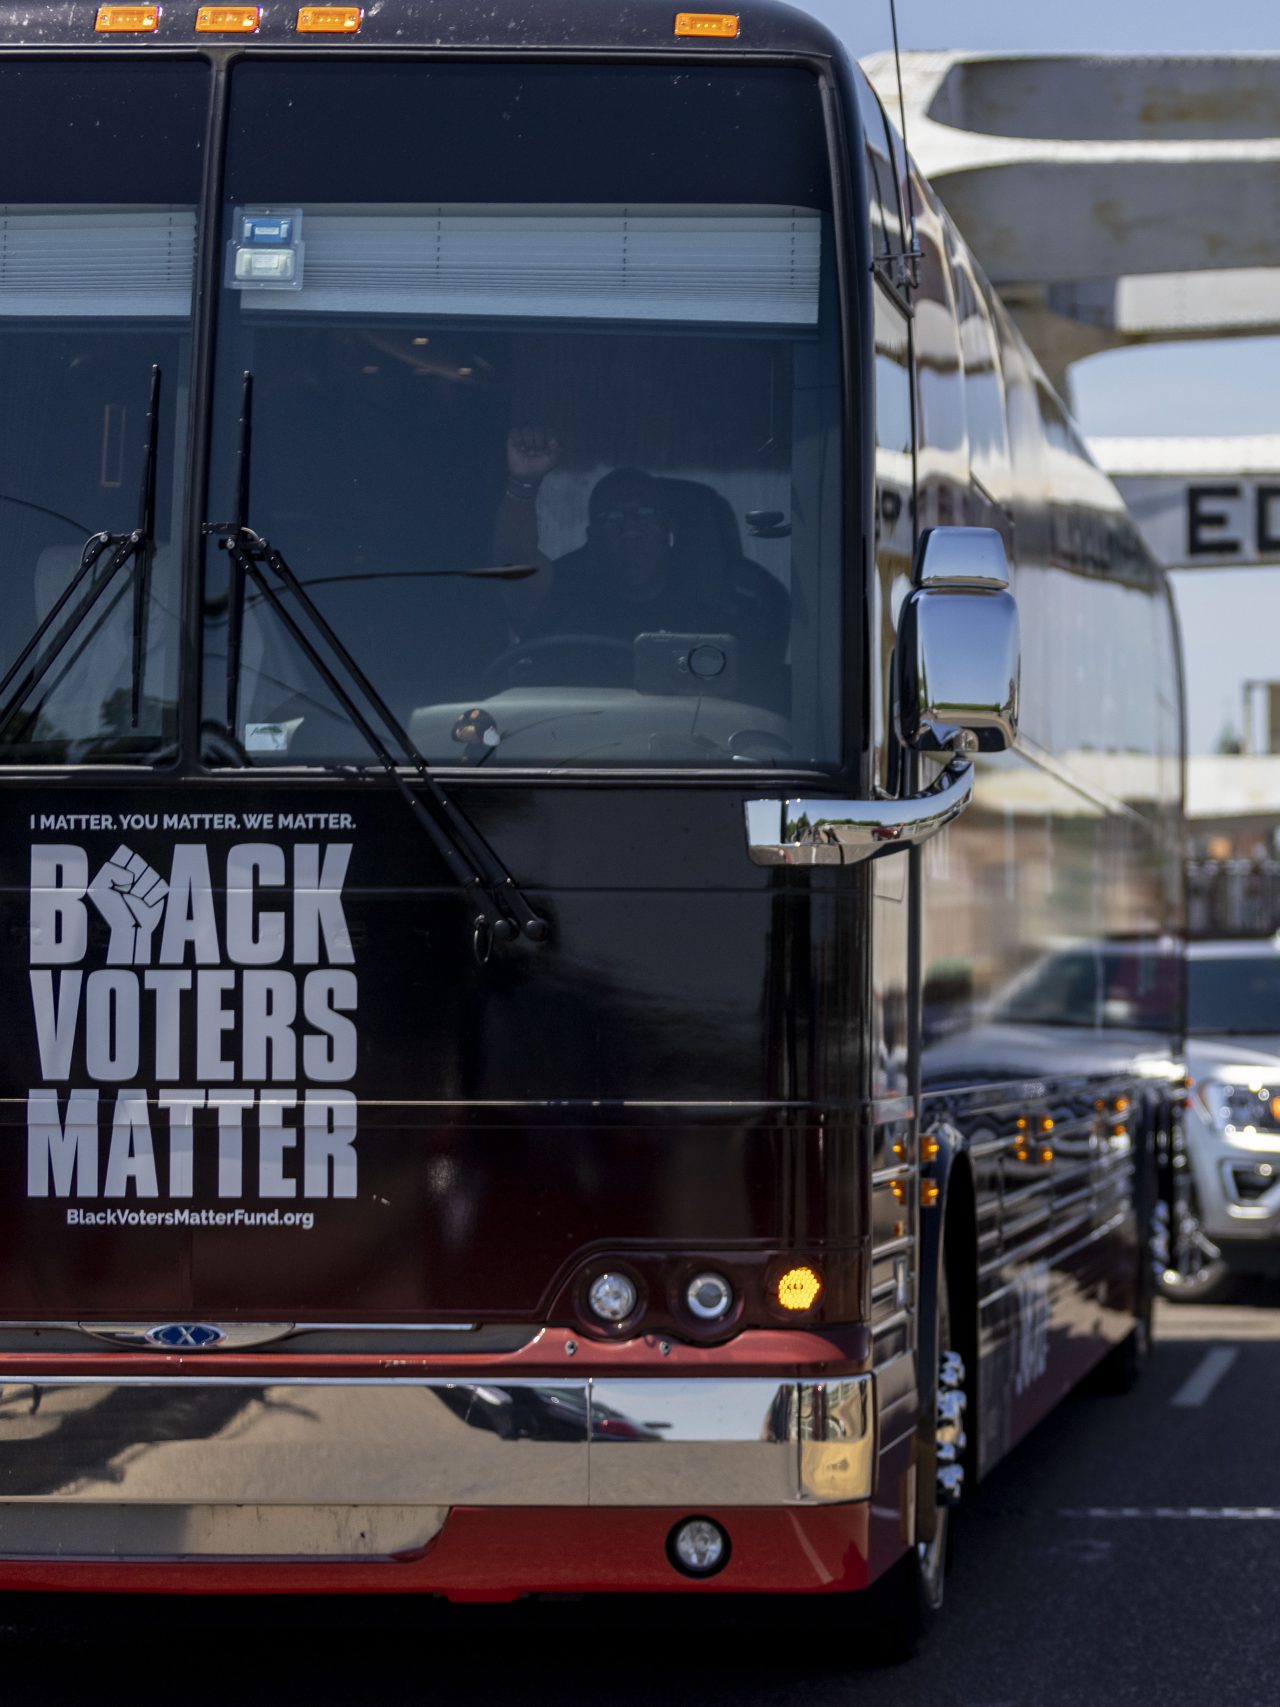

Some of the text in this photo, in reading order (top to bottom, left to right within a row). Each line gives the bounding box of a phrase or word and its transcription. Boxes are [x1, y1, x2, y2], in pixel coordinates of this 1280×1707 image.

[30, 813, 356, 830] I MATTER. YOU MATTER. WE MATTER.
[29, 842, 356, 965] BACK
[29, 969, 358, 1082] VOTERS
[27, 1088, 358, 1198] MATTER
[67, 1208, 314, 1229] BlackVotersMatterFund.org
